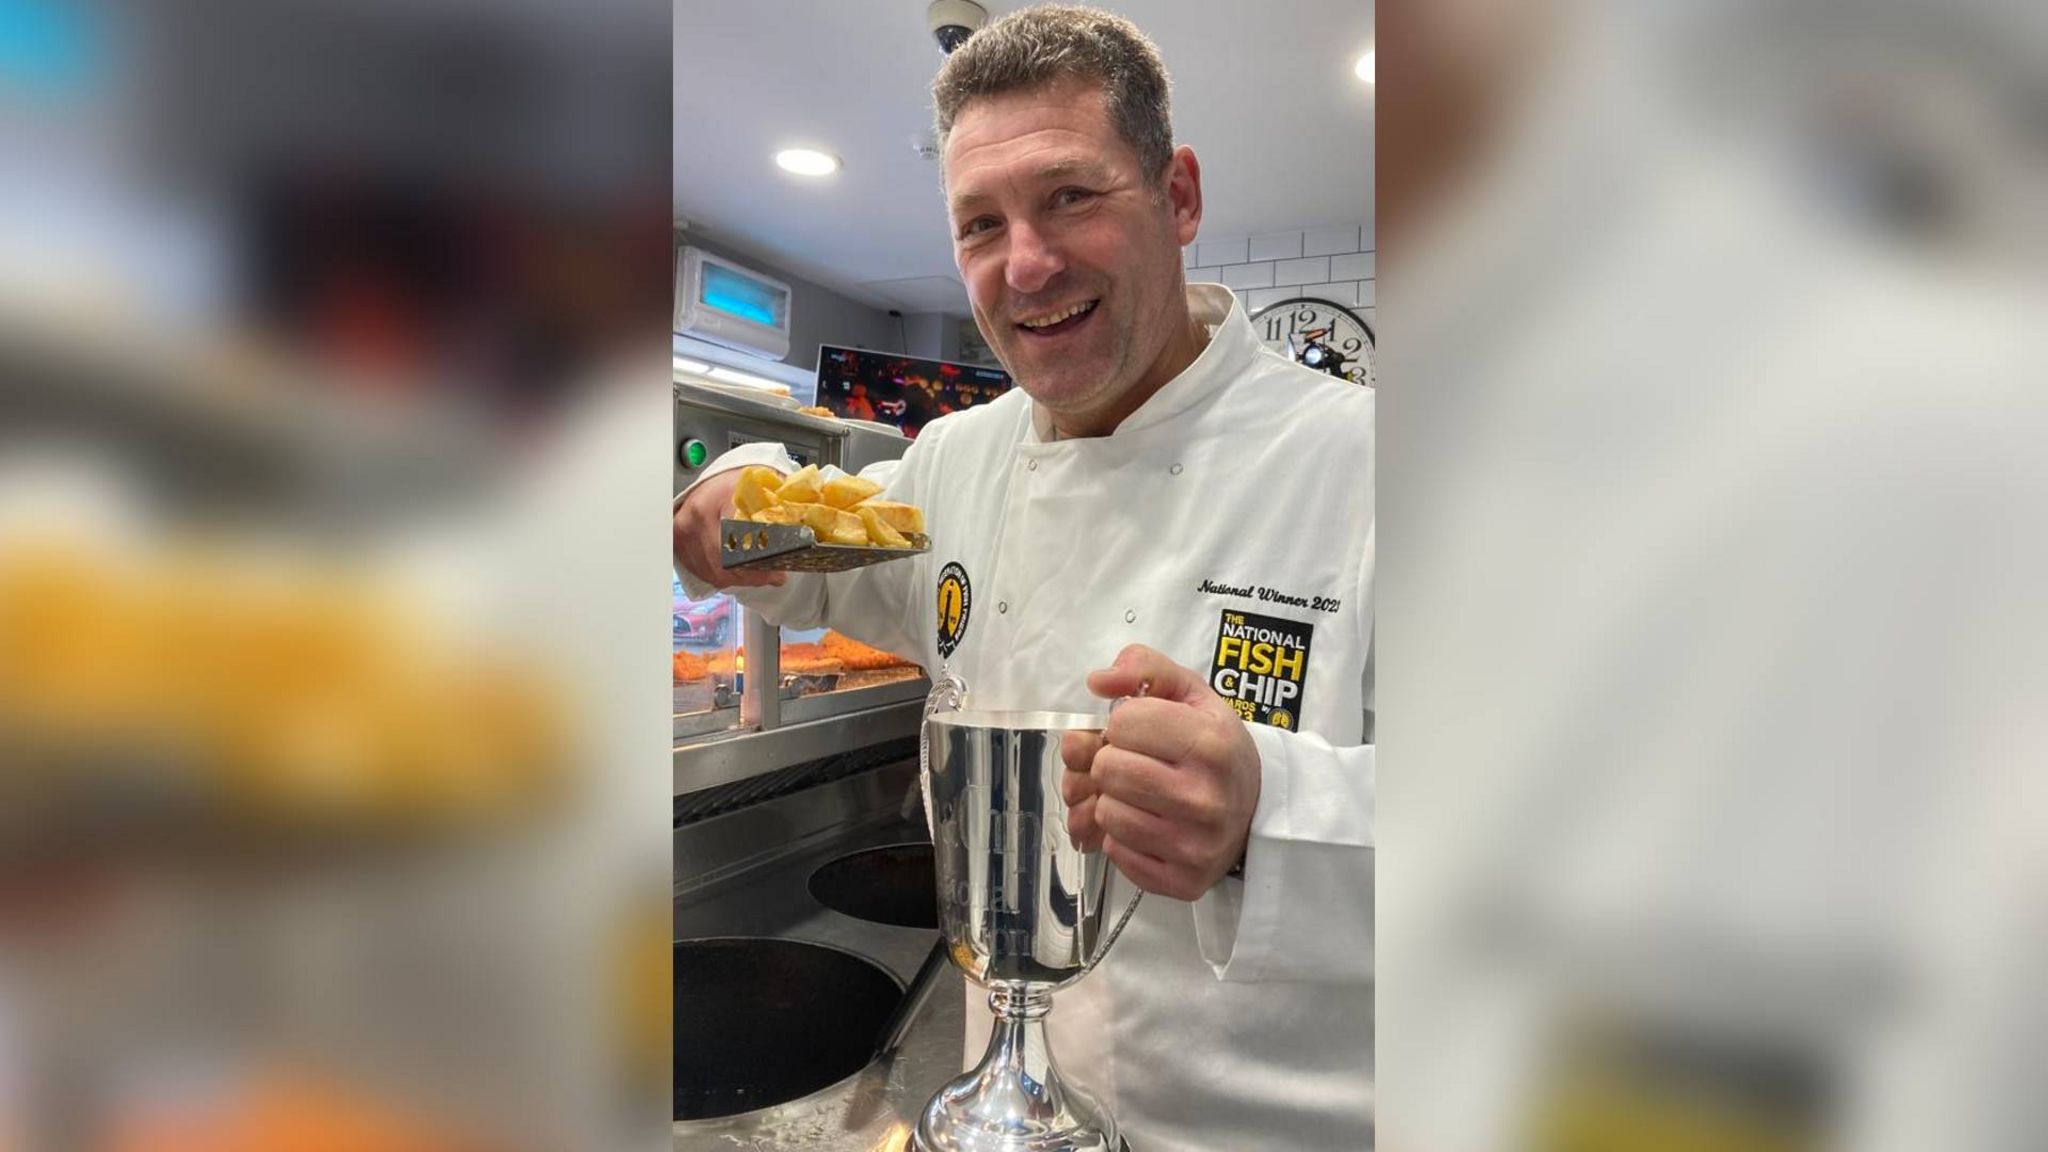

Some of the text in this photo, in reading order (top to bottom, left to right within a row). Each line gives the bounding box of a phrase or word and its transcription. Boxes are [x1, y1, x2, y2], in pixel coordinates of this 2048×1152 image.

[1265, 317, 1281, 341] 11
[1290, 310, 1316, 334] 12
[1327, 318, 1336, 342] 1
[1342, 337, 1362, 363] 2
[1197, 579, 1254, 598] National
[1257, 586, 1308, 608] Winner
[1225, 613, 1245, 625] THE
[1222, 623, 1306, 650] NATIONAL
[1217, 636, 1304, 681] FISH
[1213, 668, 1298, 707] CHIP
[1225, 677, 1233, 687] &
